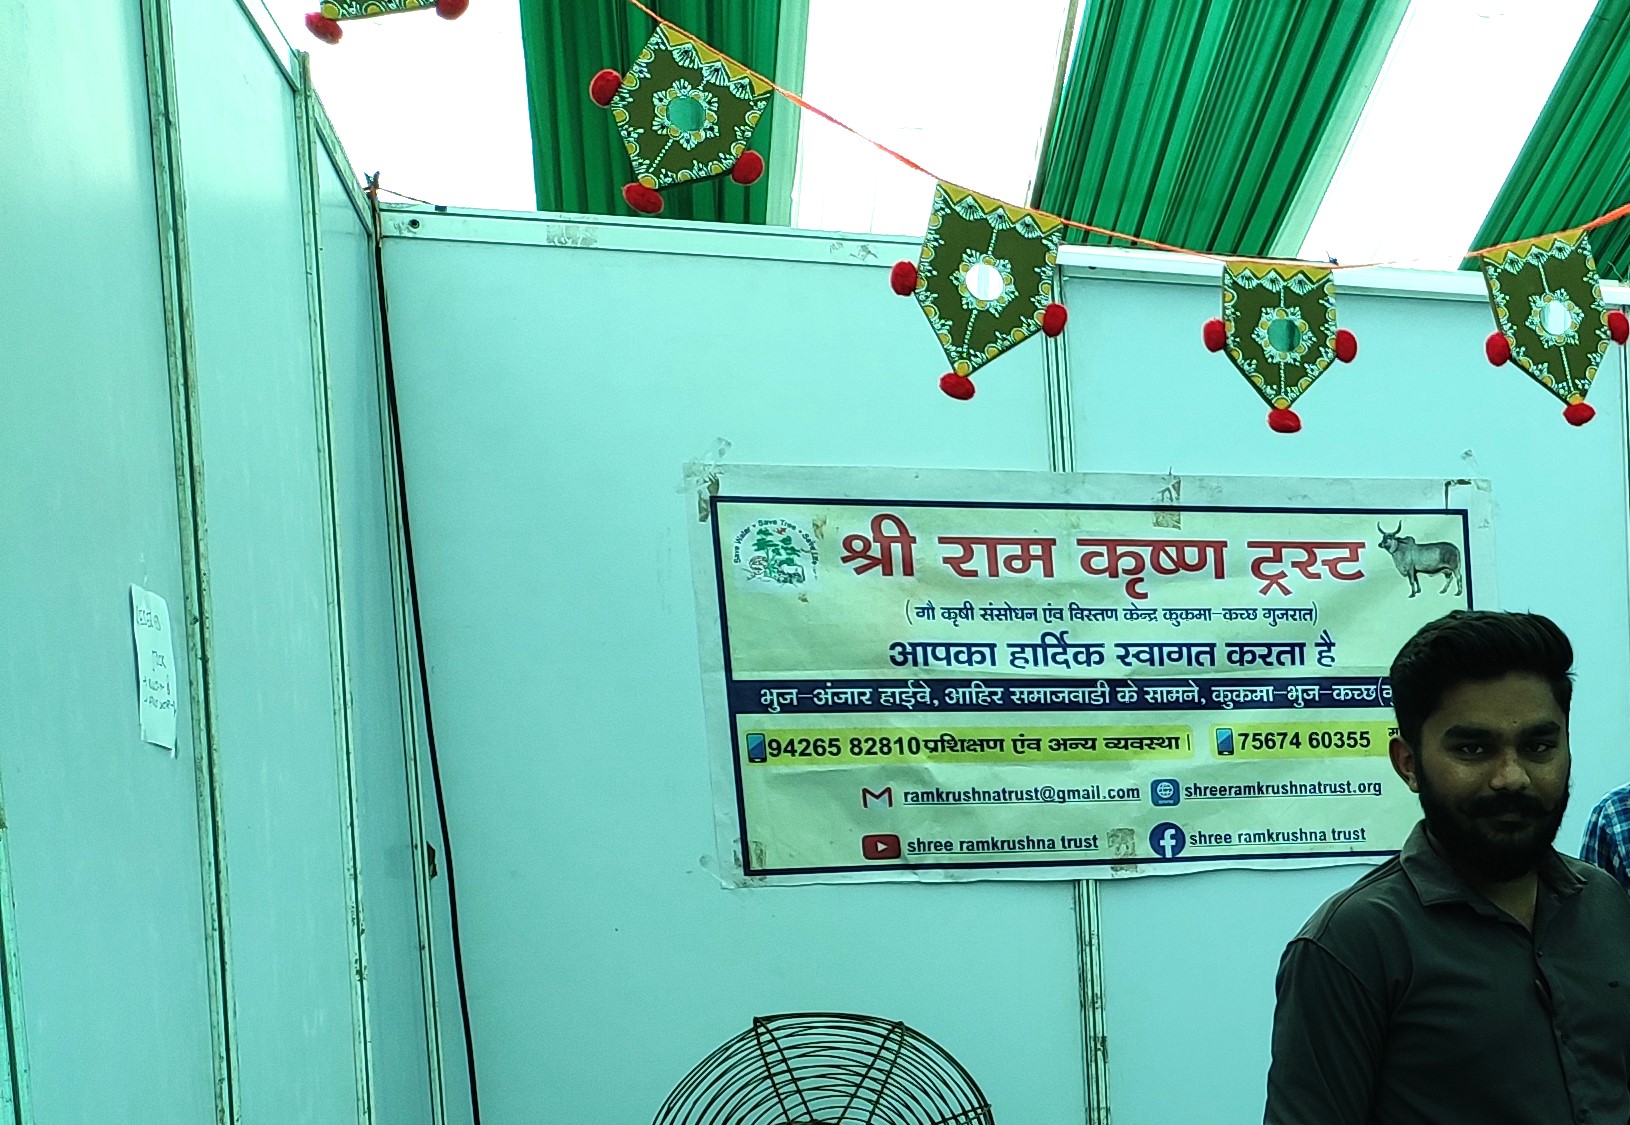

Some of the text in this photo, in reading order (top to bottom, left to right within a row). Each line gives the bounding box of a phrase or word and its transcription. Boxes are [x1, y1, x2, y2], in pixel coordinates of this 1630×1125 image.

[840, 512, 1367, 600] श्री राम कृष्ण ट्रस्ट
[941, 600, 975, 627] कृषी
[980, 600, 1038, 623] संसोधन
[1068, 602, 1119, 622] विस्तण
[1122, 603, 1159, 624] केन्द्र
[1262, 600, 1319, 627] गुजरात)
[888, 629, 1336, 669] आपका हार्दिक स्वागत करता है
[944, 680, 1004, 705] आहिर
[1009, 680, 1110, 706] समाजवाडी
[1116, 680, 1139, 705] के
[1144, 680, 1206, 707] सामने,
[768, 736, 921, 758] 94265 82810
[922, 732, 1005, 755] प्रशिक्षण
[1047, 735, 1098, 753] अन्य
[1103, 735, 1181, 752] व्यवस्था
[1238, 731, 1302, 752] 75674
[1308, 729, 1371, 750] 60355
[903, 784, 1141, 804] ramkrushnatrust@gmail.com
[1184, 779, 1382, 798] shreeramkrushnatrust.org
[907, 834, 1098, 853] shree ramkrushna trust
[1189, 827, 1366, 847] shree ramkrushna trust
